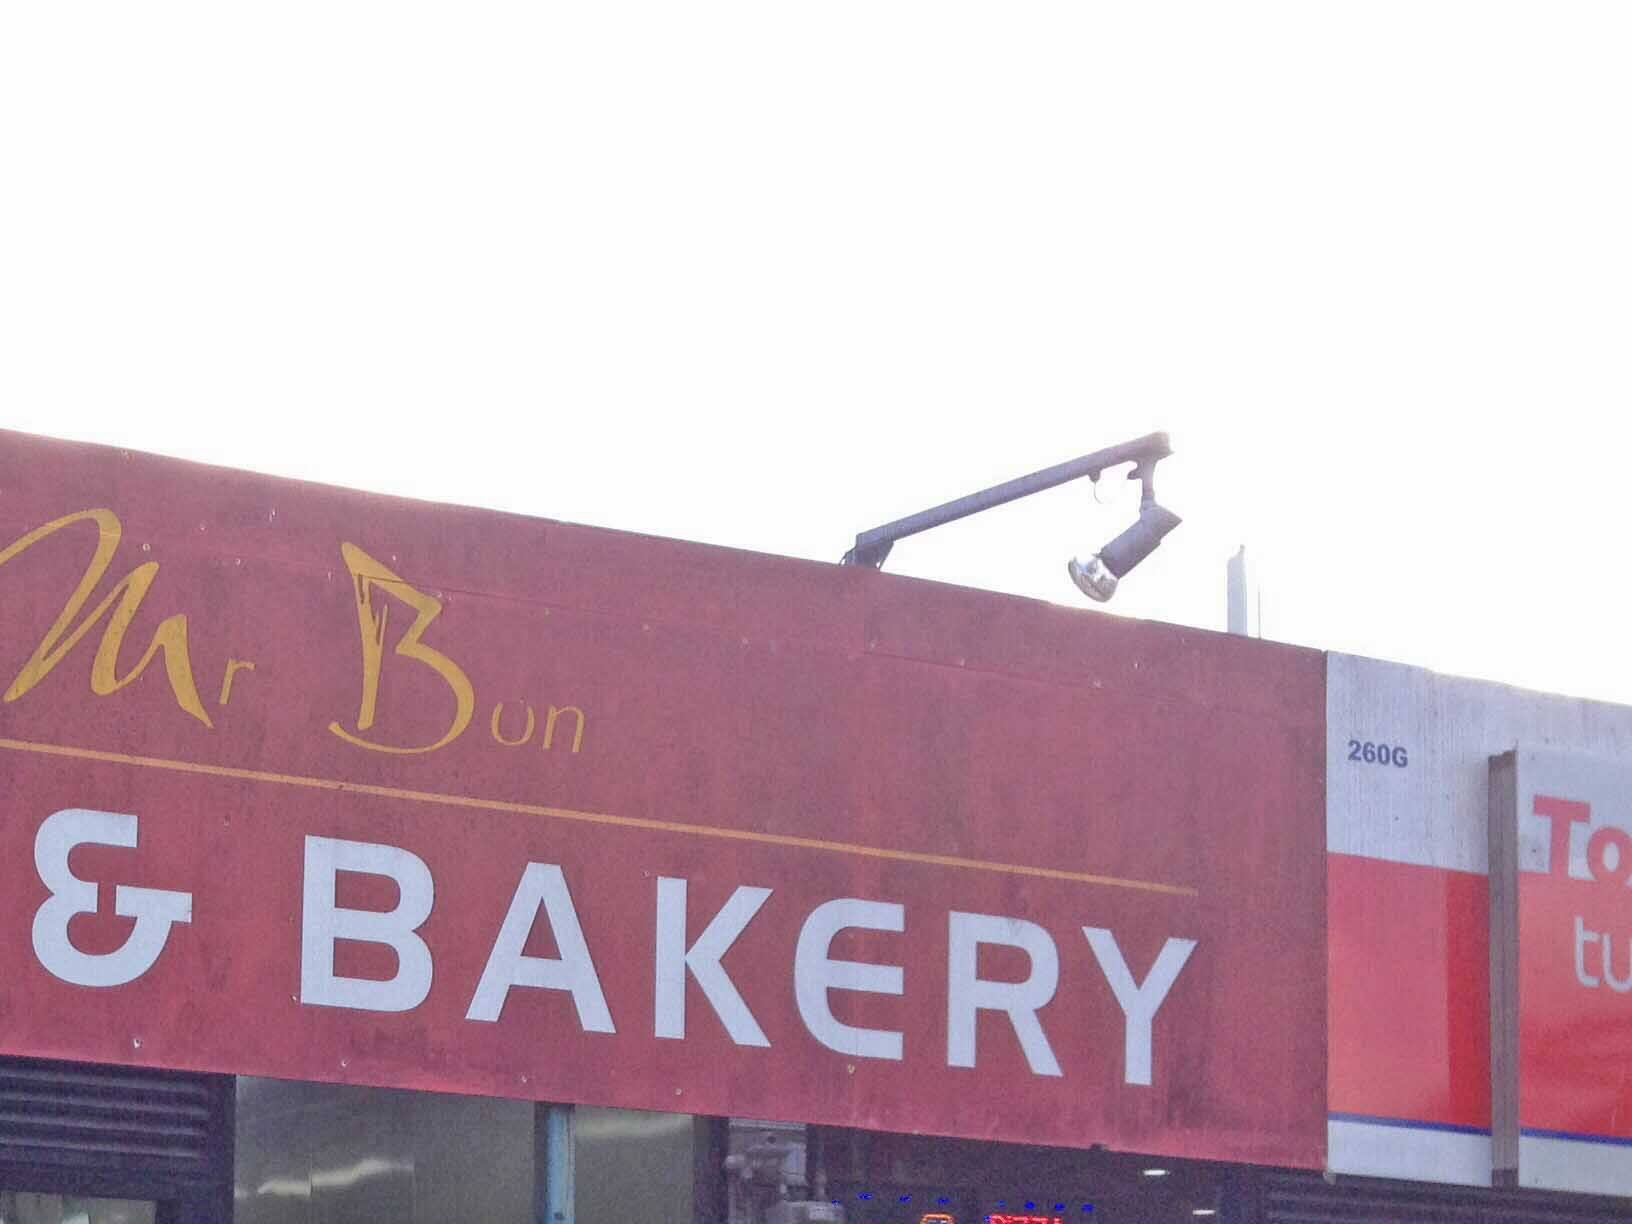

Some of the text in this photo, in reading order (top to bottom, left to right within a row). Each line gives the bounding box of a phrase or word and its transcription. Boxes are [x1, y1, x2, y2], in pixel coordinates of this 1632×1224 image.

[328, 542, 585, 754] Bun
[1348, 740, 1408, 768] 260G
[31, 807, 193, 989] &
[299, 834, 1199, 1087] BAKERY
